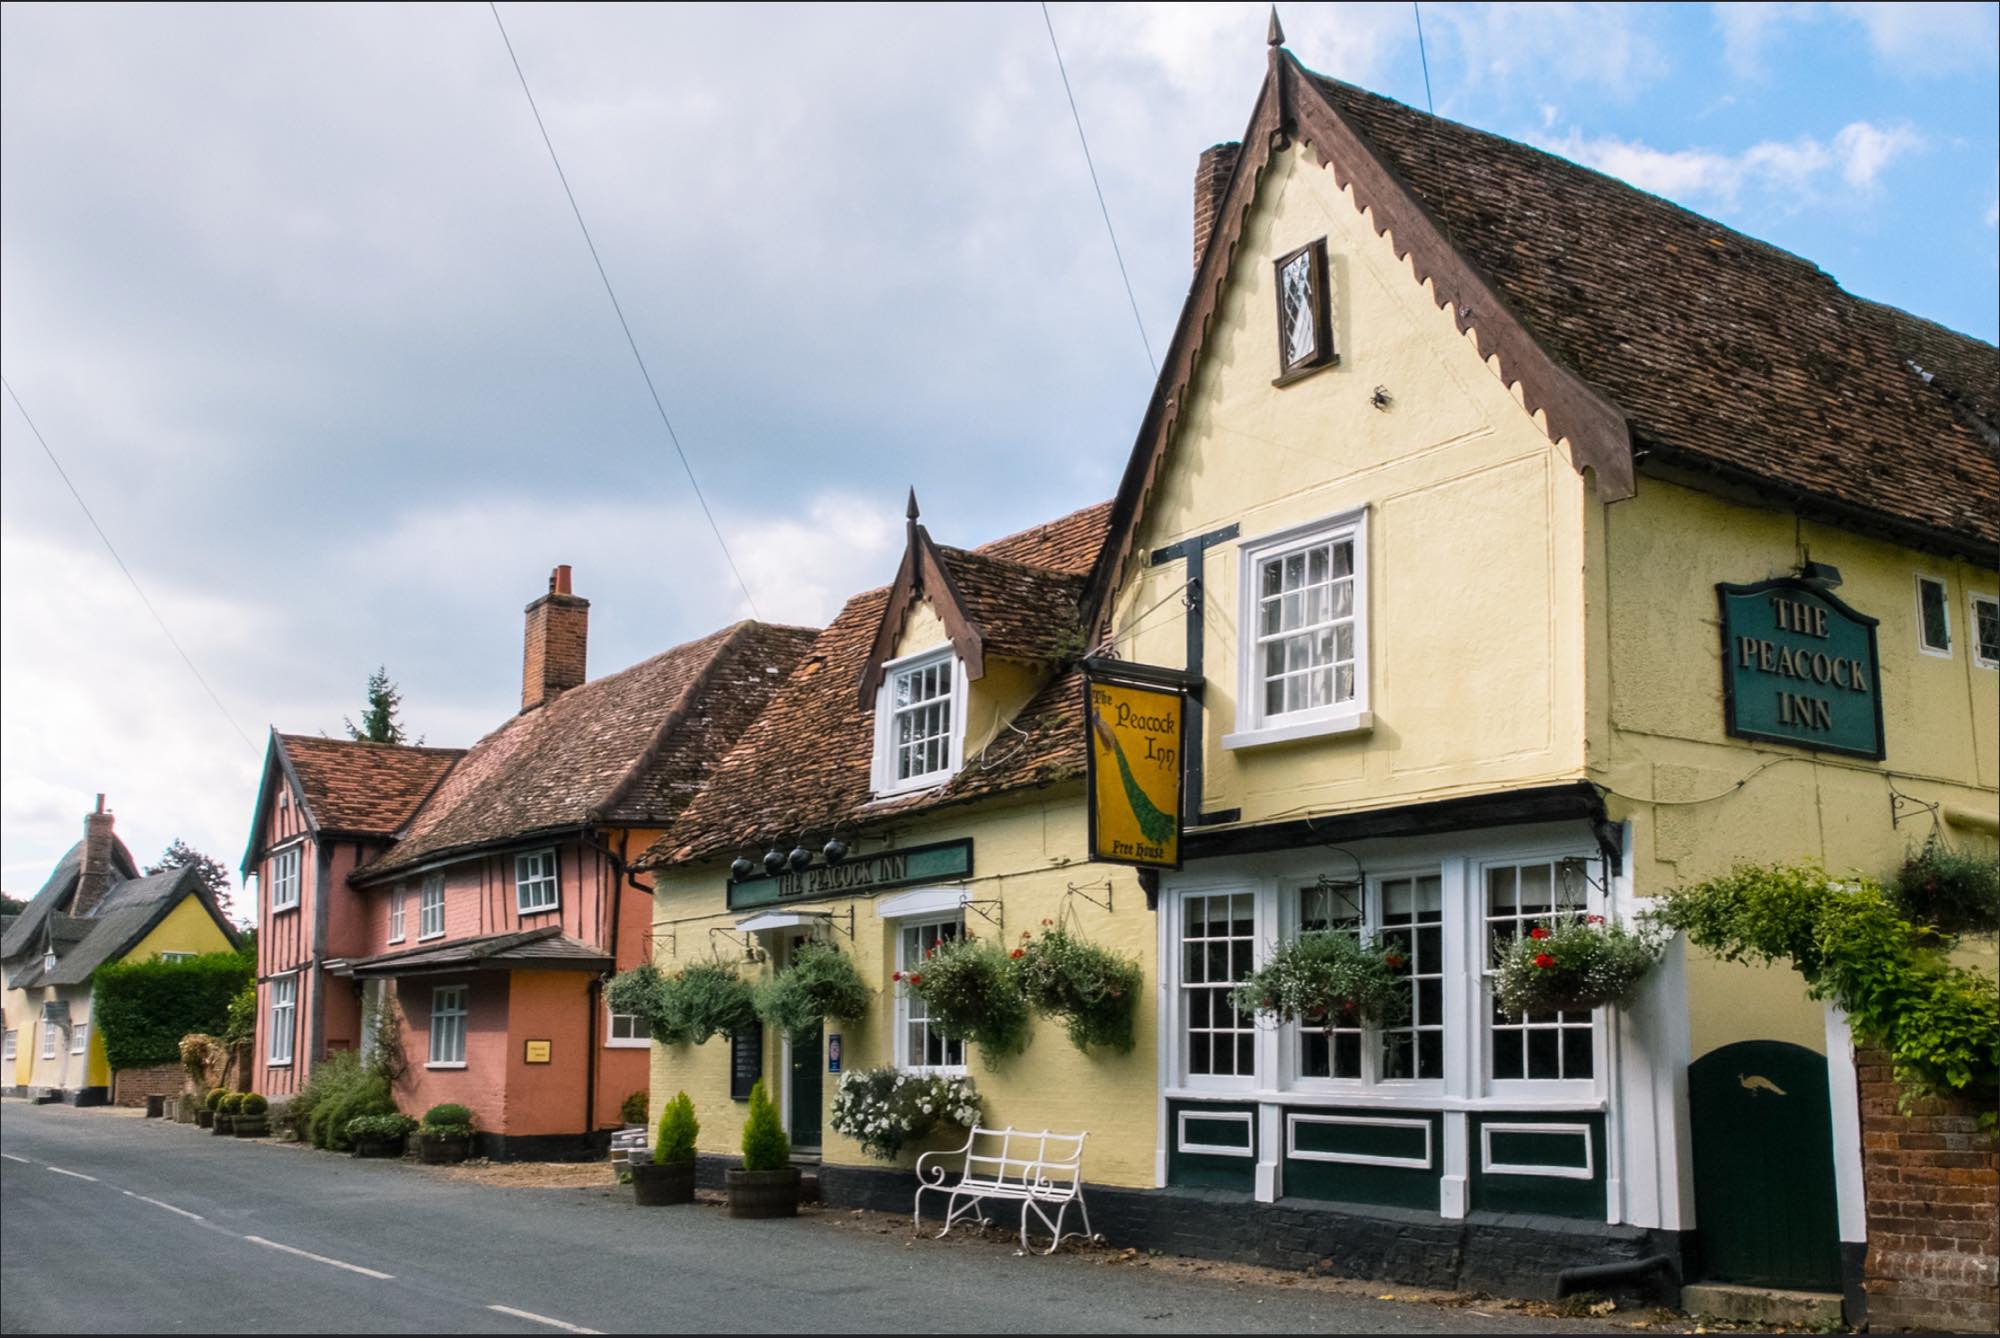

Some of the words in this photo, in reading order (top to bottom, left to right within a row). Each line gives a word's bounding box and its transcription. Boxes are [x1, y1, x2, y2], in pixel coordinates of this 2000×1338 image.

[1770, 598, 1830, 638] THE
[1738, 636, 1868, 692] PEACOCK
[1092, 689, 1112, 706] The
[1777, 691, 1831, 730] INN
[1115, 702, 1175, 734] Peacock
[1144, 736, 1175, 771] Inn
[1112, 840, 1133, 855] Free
[777, 871, 803, 896] THE
[808, 861, 874, 892] PEACOCK
[880, 854, 907, 880] INN
